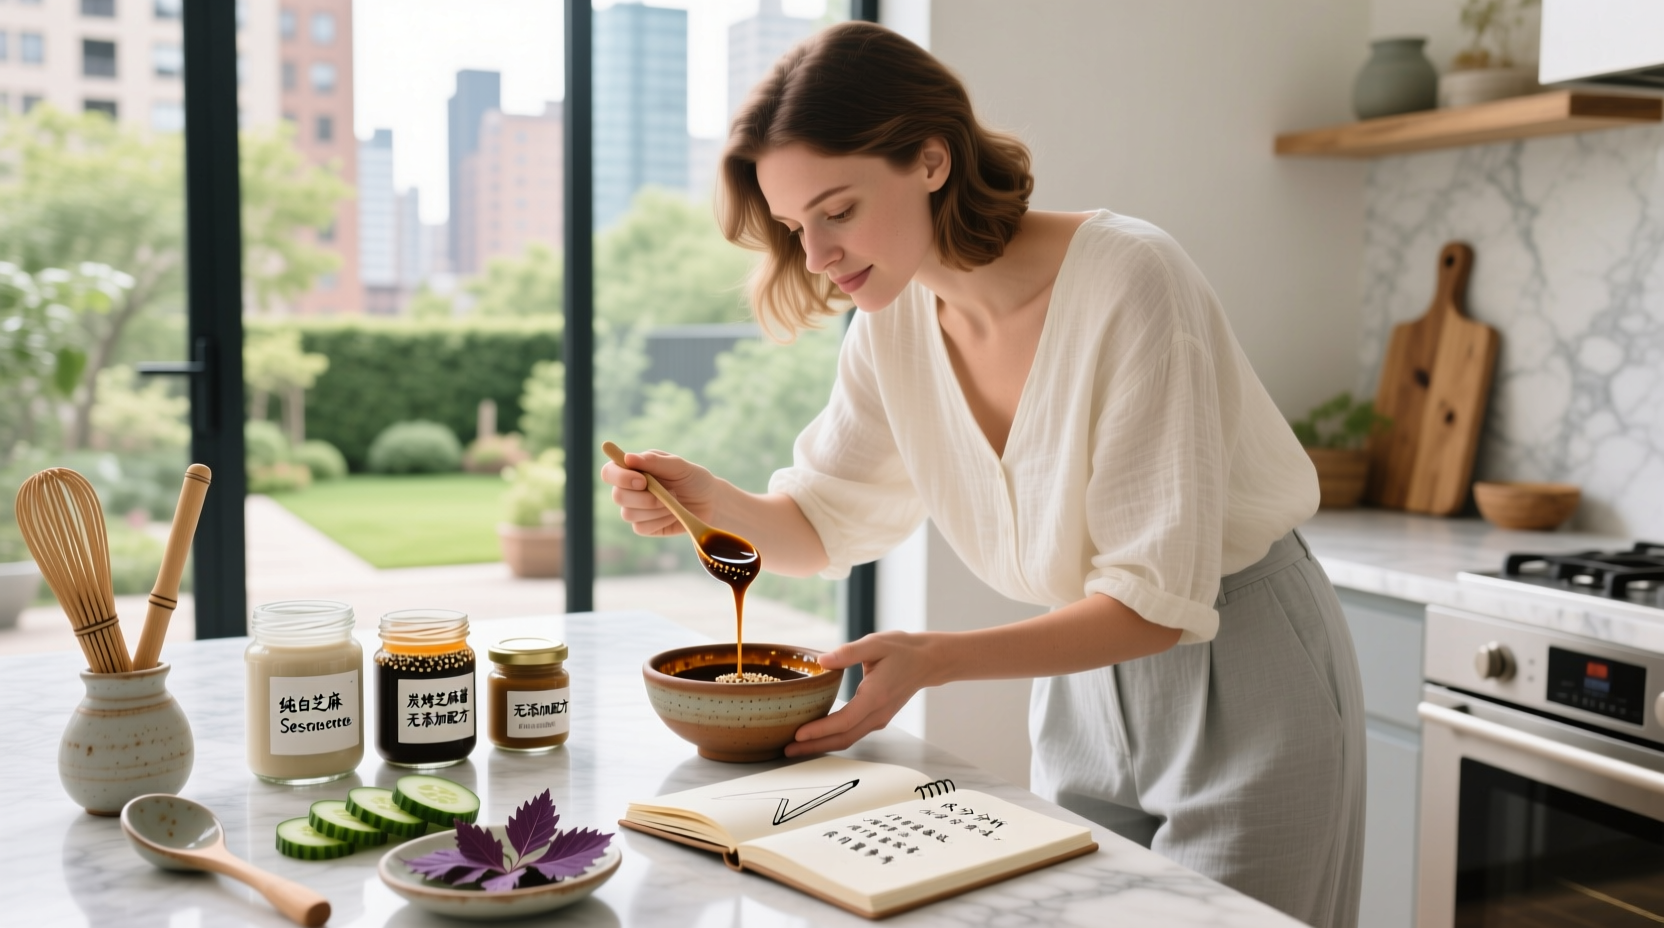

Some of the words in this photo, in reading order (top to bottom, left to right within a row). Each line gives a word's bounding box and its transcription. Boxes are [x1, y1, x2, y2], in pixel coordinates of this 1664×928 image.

[279, 691, 343, 713] 纯白芝麻
[407, 707, 470, 728] 无添加配方
